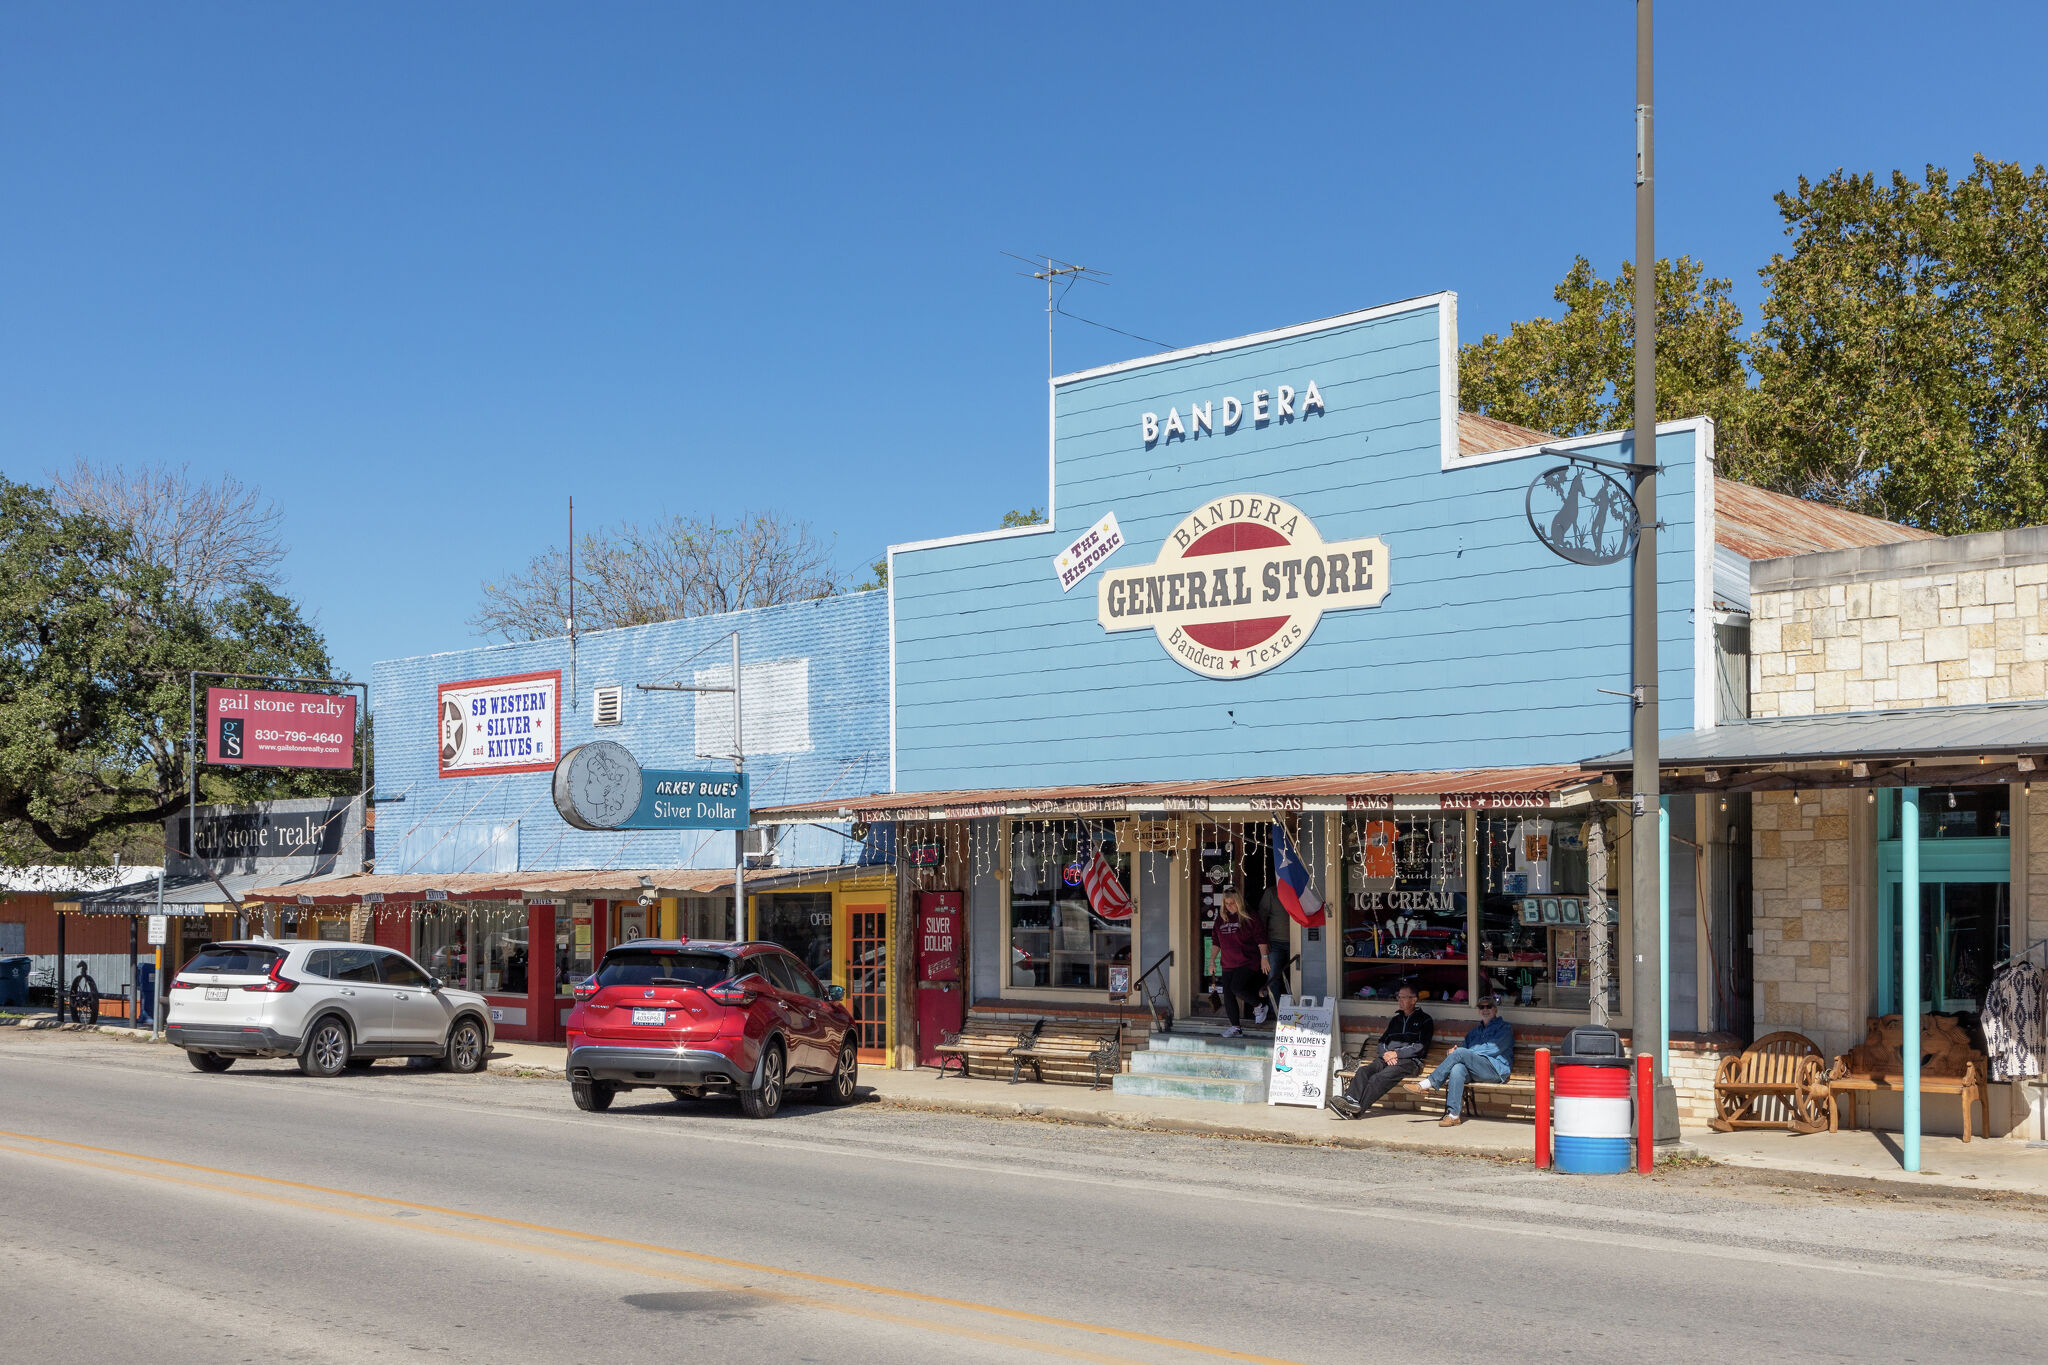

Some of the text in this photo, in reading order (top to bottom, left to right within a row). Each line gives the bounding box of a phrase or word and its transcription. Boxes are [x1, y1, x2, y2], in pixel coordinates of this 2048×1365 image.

[1141, 379, 1325, 442] BANDERA
[1173, 498, 1299, 549] BANDERA
[1070, 530, 1100, 559] THE
[1062, 532, 1120, 586] HISTORIC
[1107, 549, 1373, 618] GENERAL STORE
[1168, 623, 1302, 670] Bandera Texas
[218, 693, 345, 718] gail stone realty
[472, 692, 547, 716] SB WESTERN
[487, 716, 531, 737] SILVER
[255, 729, 343, 744] 830-796-4640
[258, 744, 340, 754] www.gailstonerealty.com
[472, 737, 532, 758] and KNIVES
[655, 780, 738, 797] ARKEY BLUE'S
[654, 800, 737, 819] Silver Dollar
[1031, 799, 1125, 813] SODA FOUNTAIN
[1165, 799, 1207, 810] MALTS
[1251, 798, 1301, 811] SALSAS
[1351, 795, 1389, 809] JAMS
[1443, 792, 1545, 809] ART BOOKS
[860, 808, 926, 821] TEXAS GIFTS
[227, 827, 268, 848] stone
[1353, 890, 1456, 911] ICE CREAM
[926, 917, 950, 933] SILVER
[924, 935, 953, 952] DOLLAR
[1275, 1036, 1326, 1046] MEN'S, WOMEN'S
[1299, 1049, 1317, 1057] KID'S
